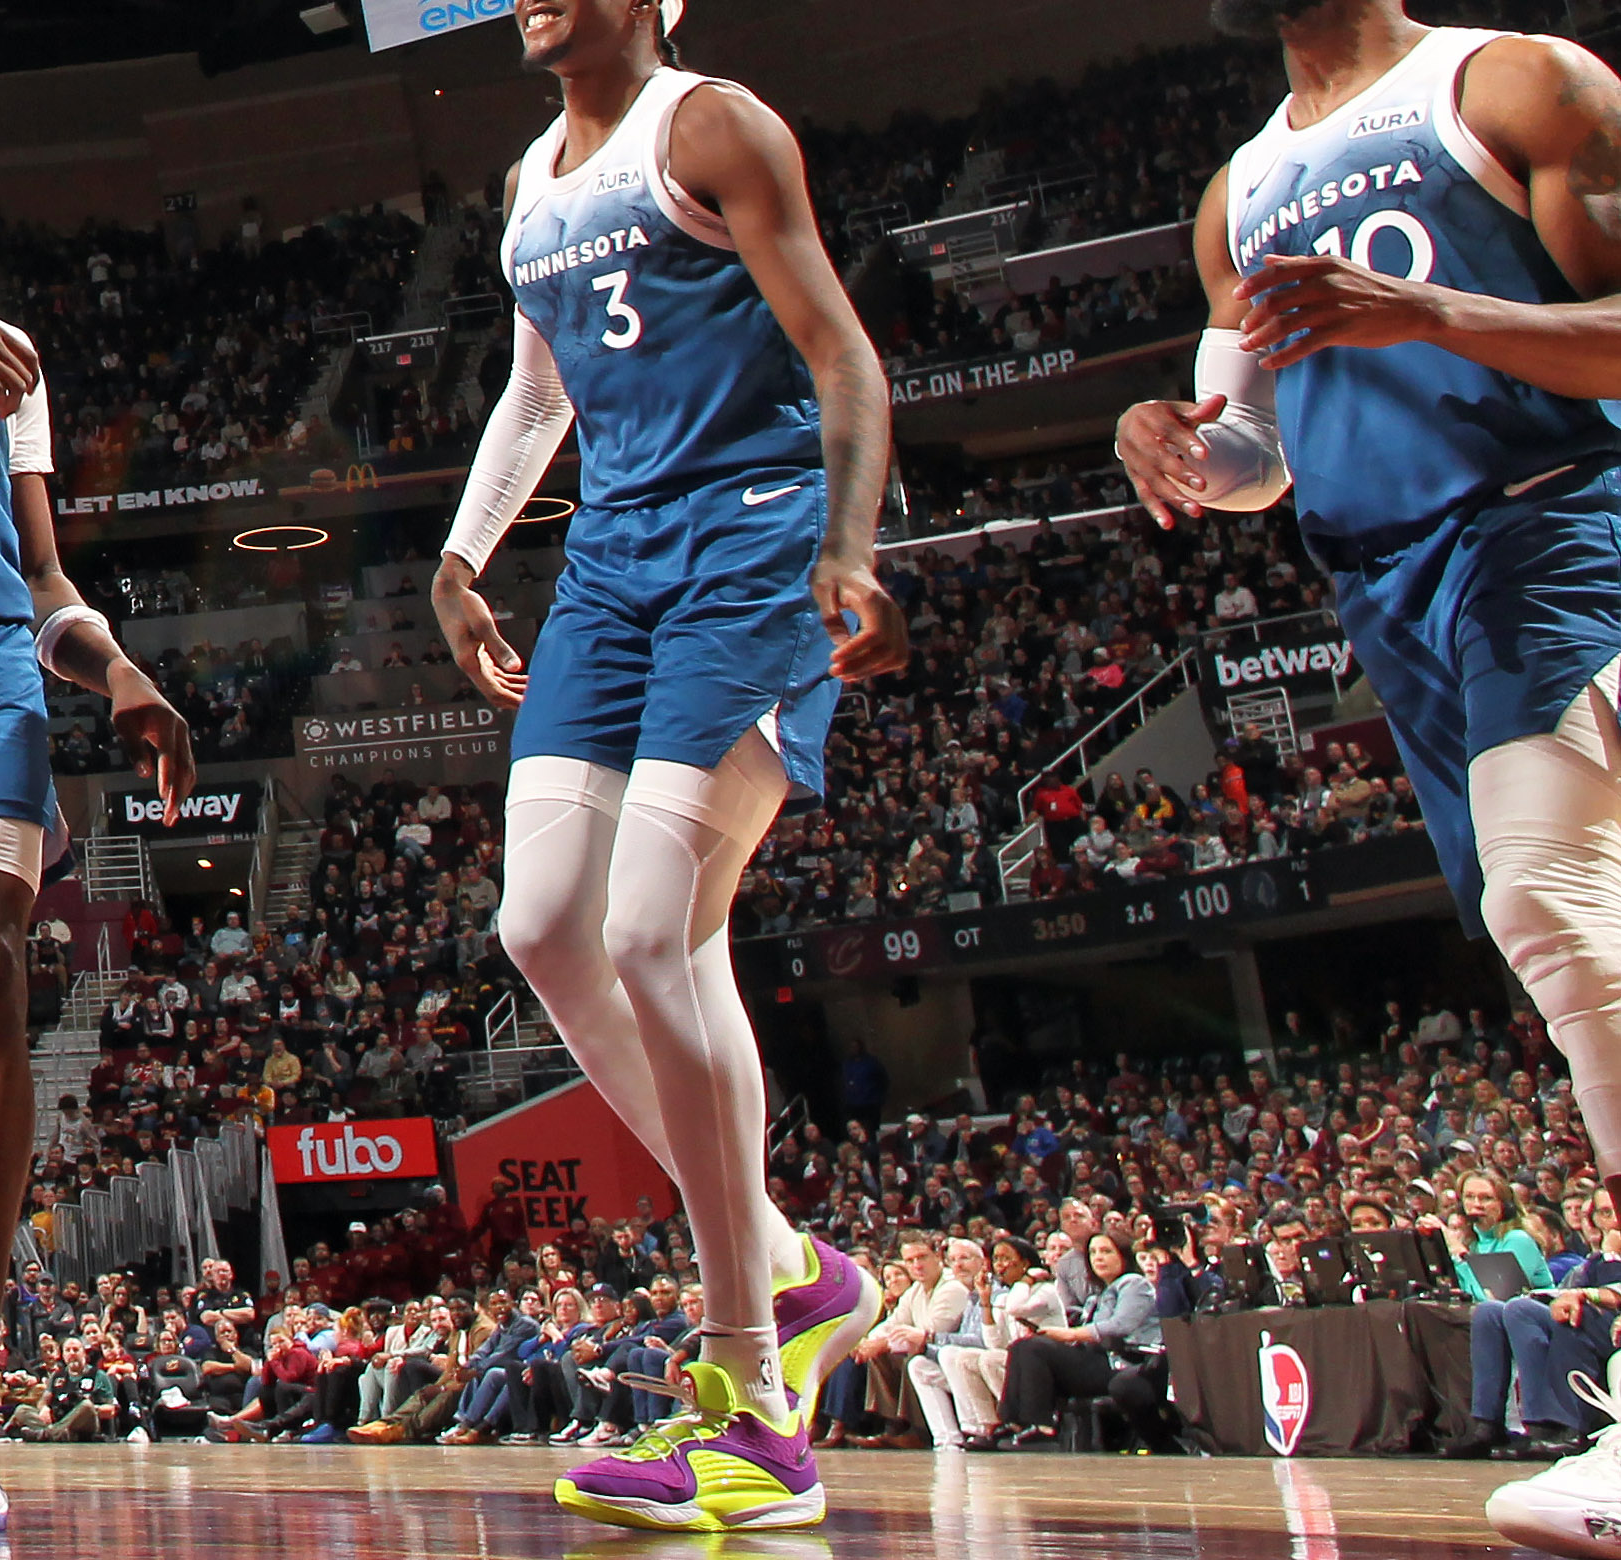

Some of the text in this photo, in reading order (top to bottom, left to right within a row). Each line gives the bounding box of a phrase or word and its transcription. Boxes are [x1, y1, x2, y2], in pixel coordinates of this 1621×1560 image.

[1240, 159, 1423, 268] MINNESOTA
[514, 225, 650, 288] MINNESOTA
[591, 269, 643, 350] 3
[890, 349, 1076, 406] AC ON THE APP
[57, 478, 265, 515] LET EM KNOW.
[1214, 640, 1351, 687] betway
[334, 708, 496, 739] WESTFIELD
[309, 740, 499, 769] CHAMPIONS CLUB
[124, 793, 242, 822] beway
[1178, 882, 1232, 921] 100
[1299, 879, 1311, 902] 1
[1032, 913, 1087, 941] 3:50
[1125, 903, 1156, 926] 3.6
[882, 929, 922, 963] 99
[954, 927, 982, 948] OT
[792, 958, 805, 978] 0
[296, 1126, 403, 1177] fubo
[499, 1158, 582, 1192] SEAT
[525, 1195, 591, 1229] EEK
